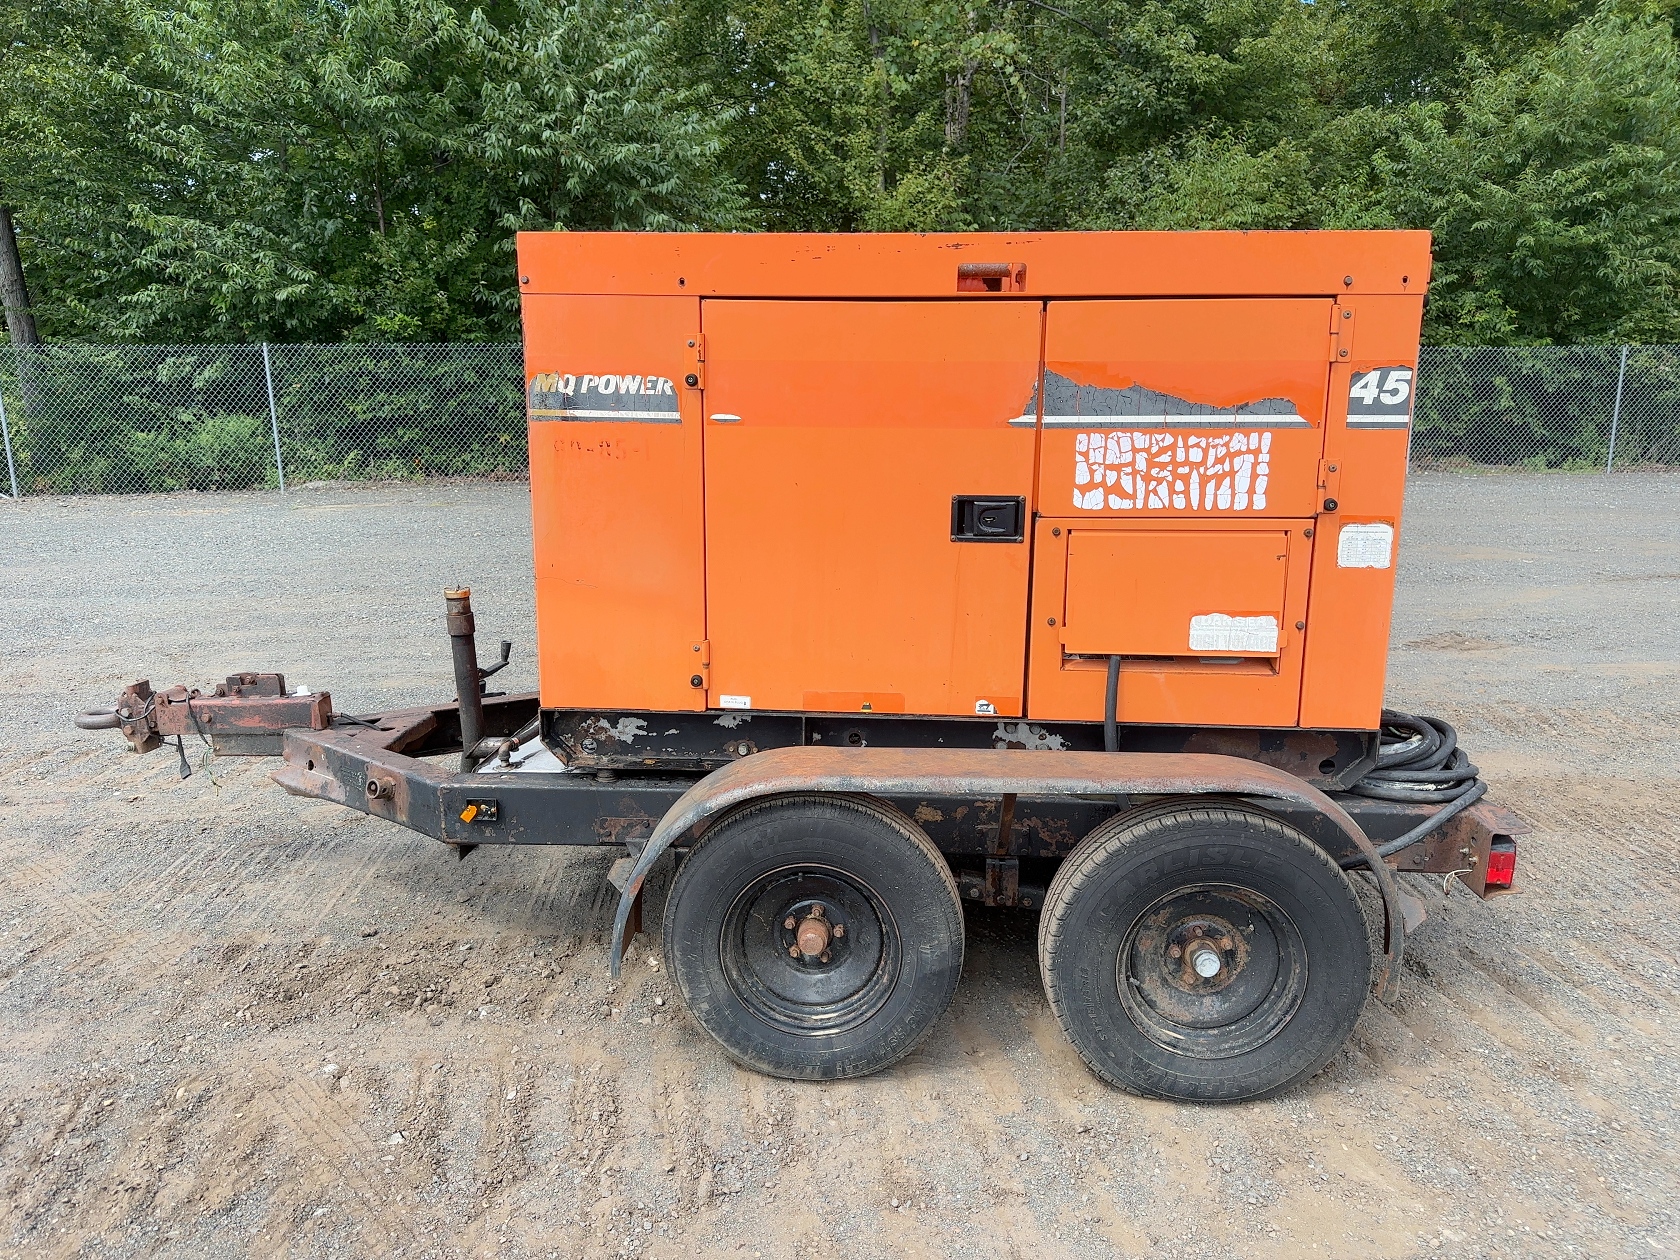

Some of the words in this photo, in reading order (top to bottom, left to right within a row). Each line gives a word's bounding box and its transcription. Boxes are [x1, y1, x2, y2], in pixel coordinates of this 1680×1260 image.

[535, 372, 577, 396] MQ
[580, 374, 674, 395] POWER
[1349, 371, 1413, 405] 45
[1099, 847, 1283, 917] CARLISLE
